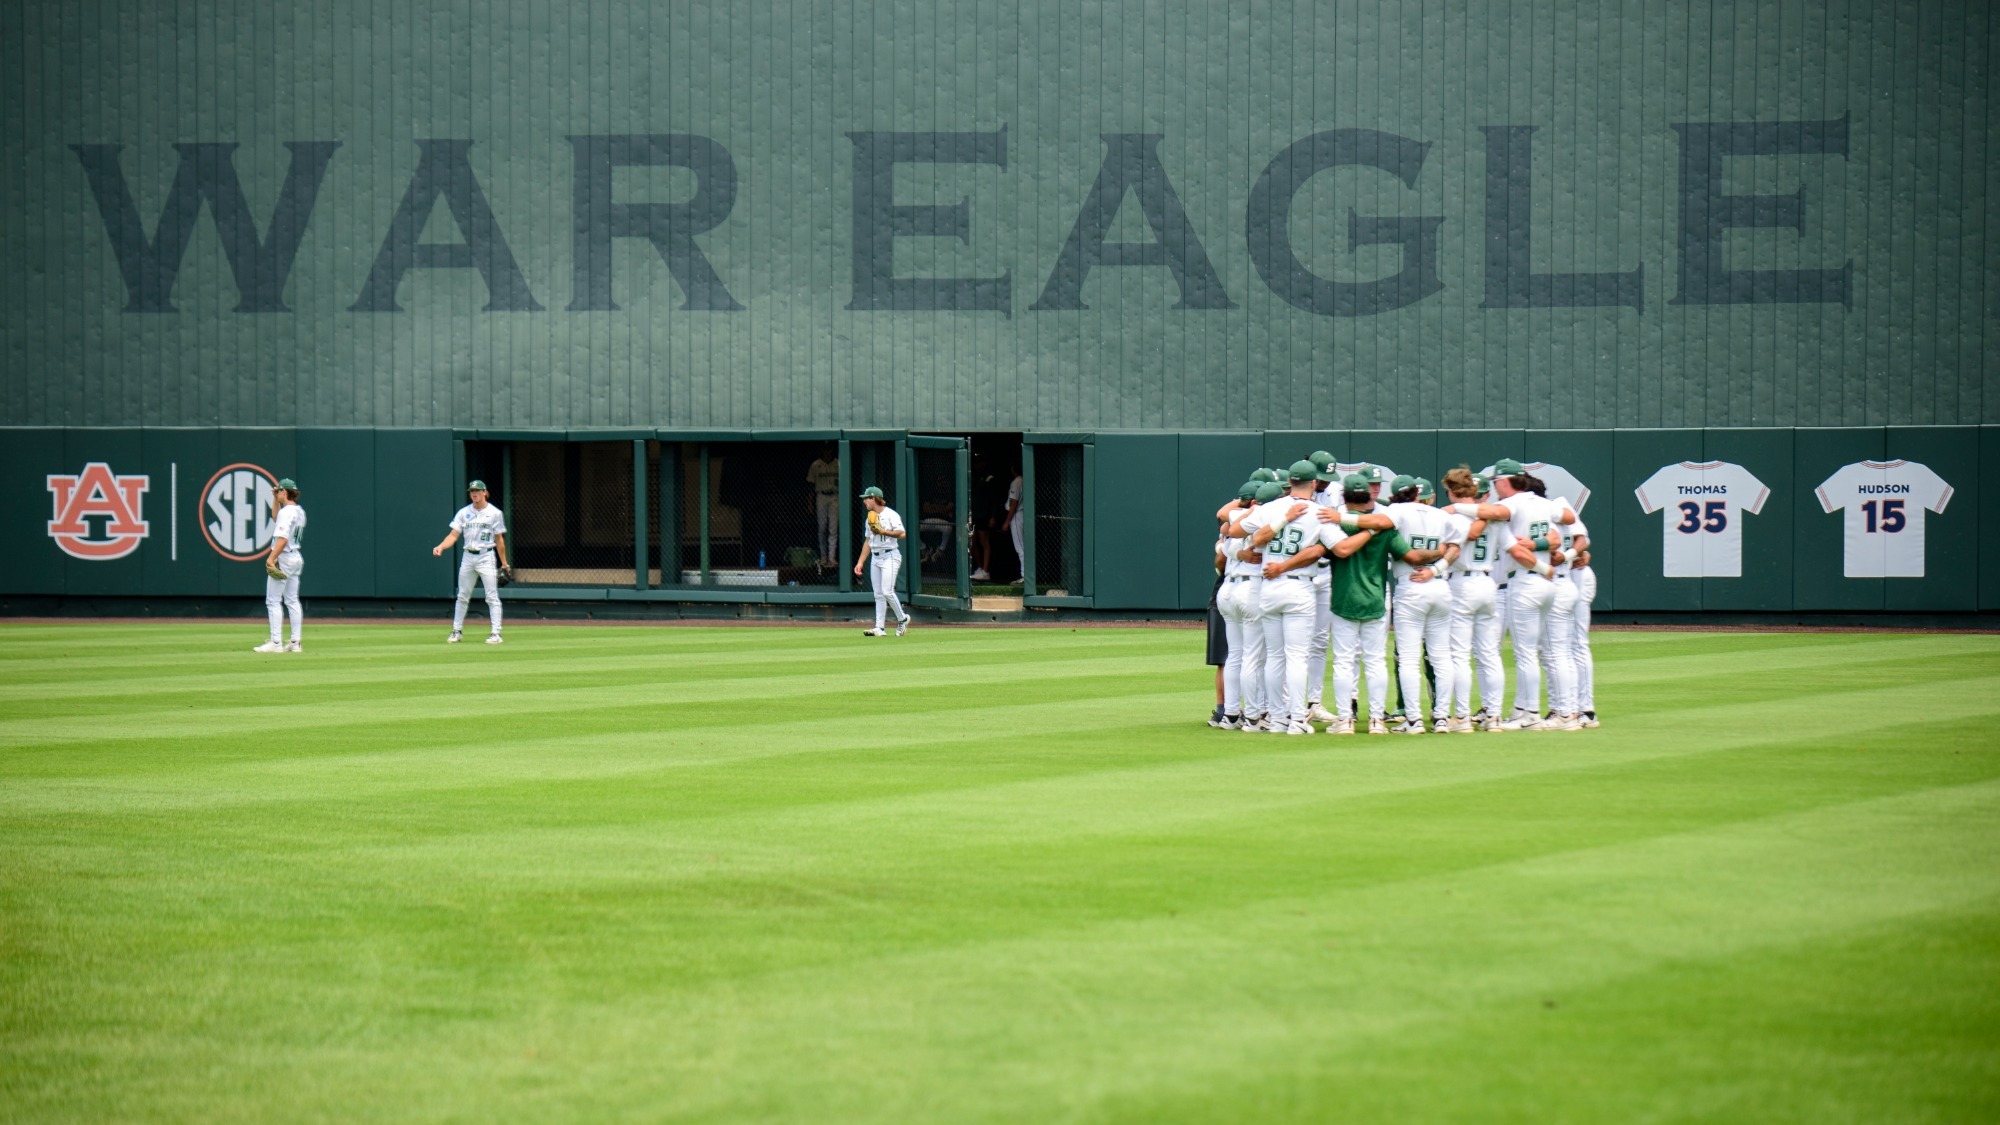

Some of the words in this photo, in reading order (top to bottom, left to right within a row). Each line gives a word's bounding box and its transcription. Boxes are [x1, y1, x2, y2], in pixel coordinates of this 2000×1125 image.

[68, 133, 746, 313] WAR
[843, 110, 1853, 318] EAGLE
[1325, 462, 1335, 474] S
[1372, 467, 1381, 478] S
[1677, 485, 1727, 495] THOMAS
[1858, 484, 1910, 494] HUDSON
[1676, 499, 1728, 534] 35
[1861, 498, 1907, 534] 15
[1267, 525, 1304, 556] 33
[1473, 532, 1488, 563] 5
